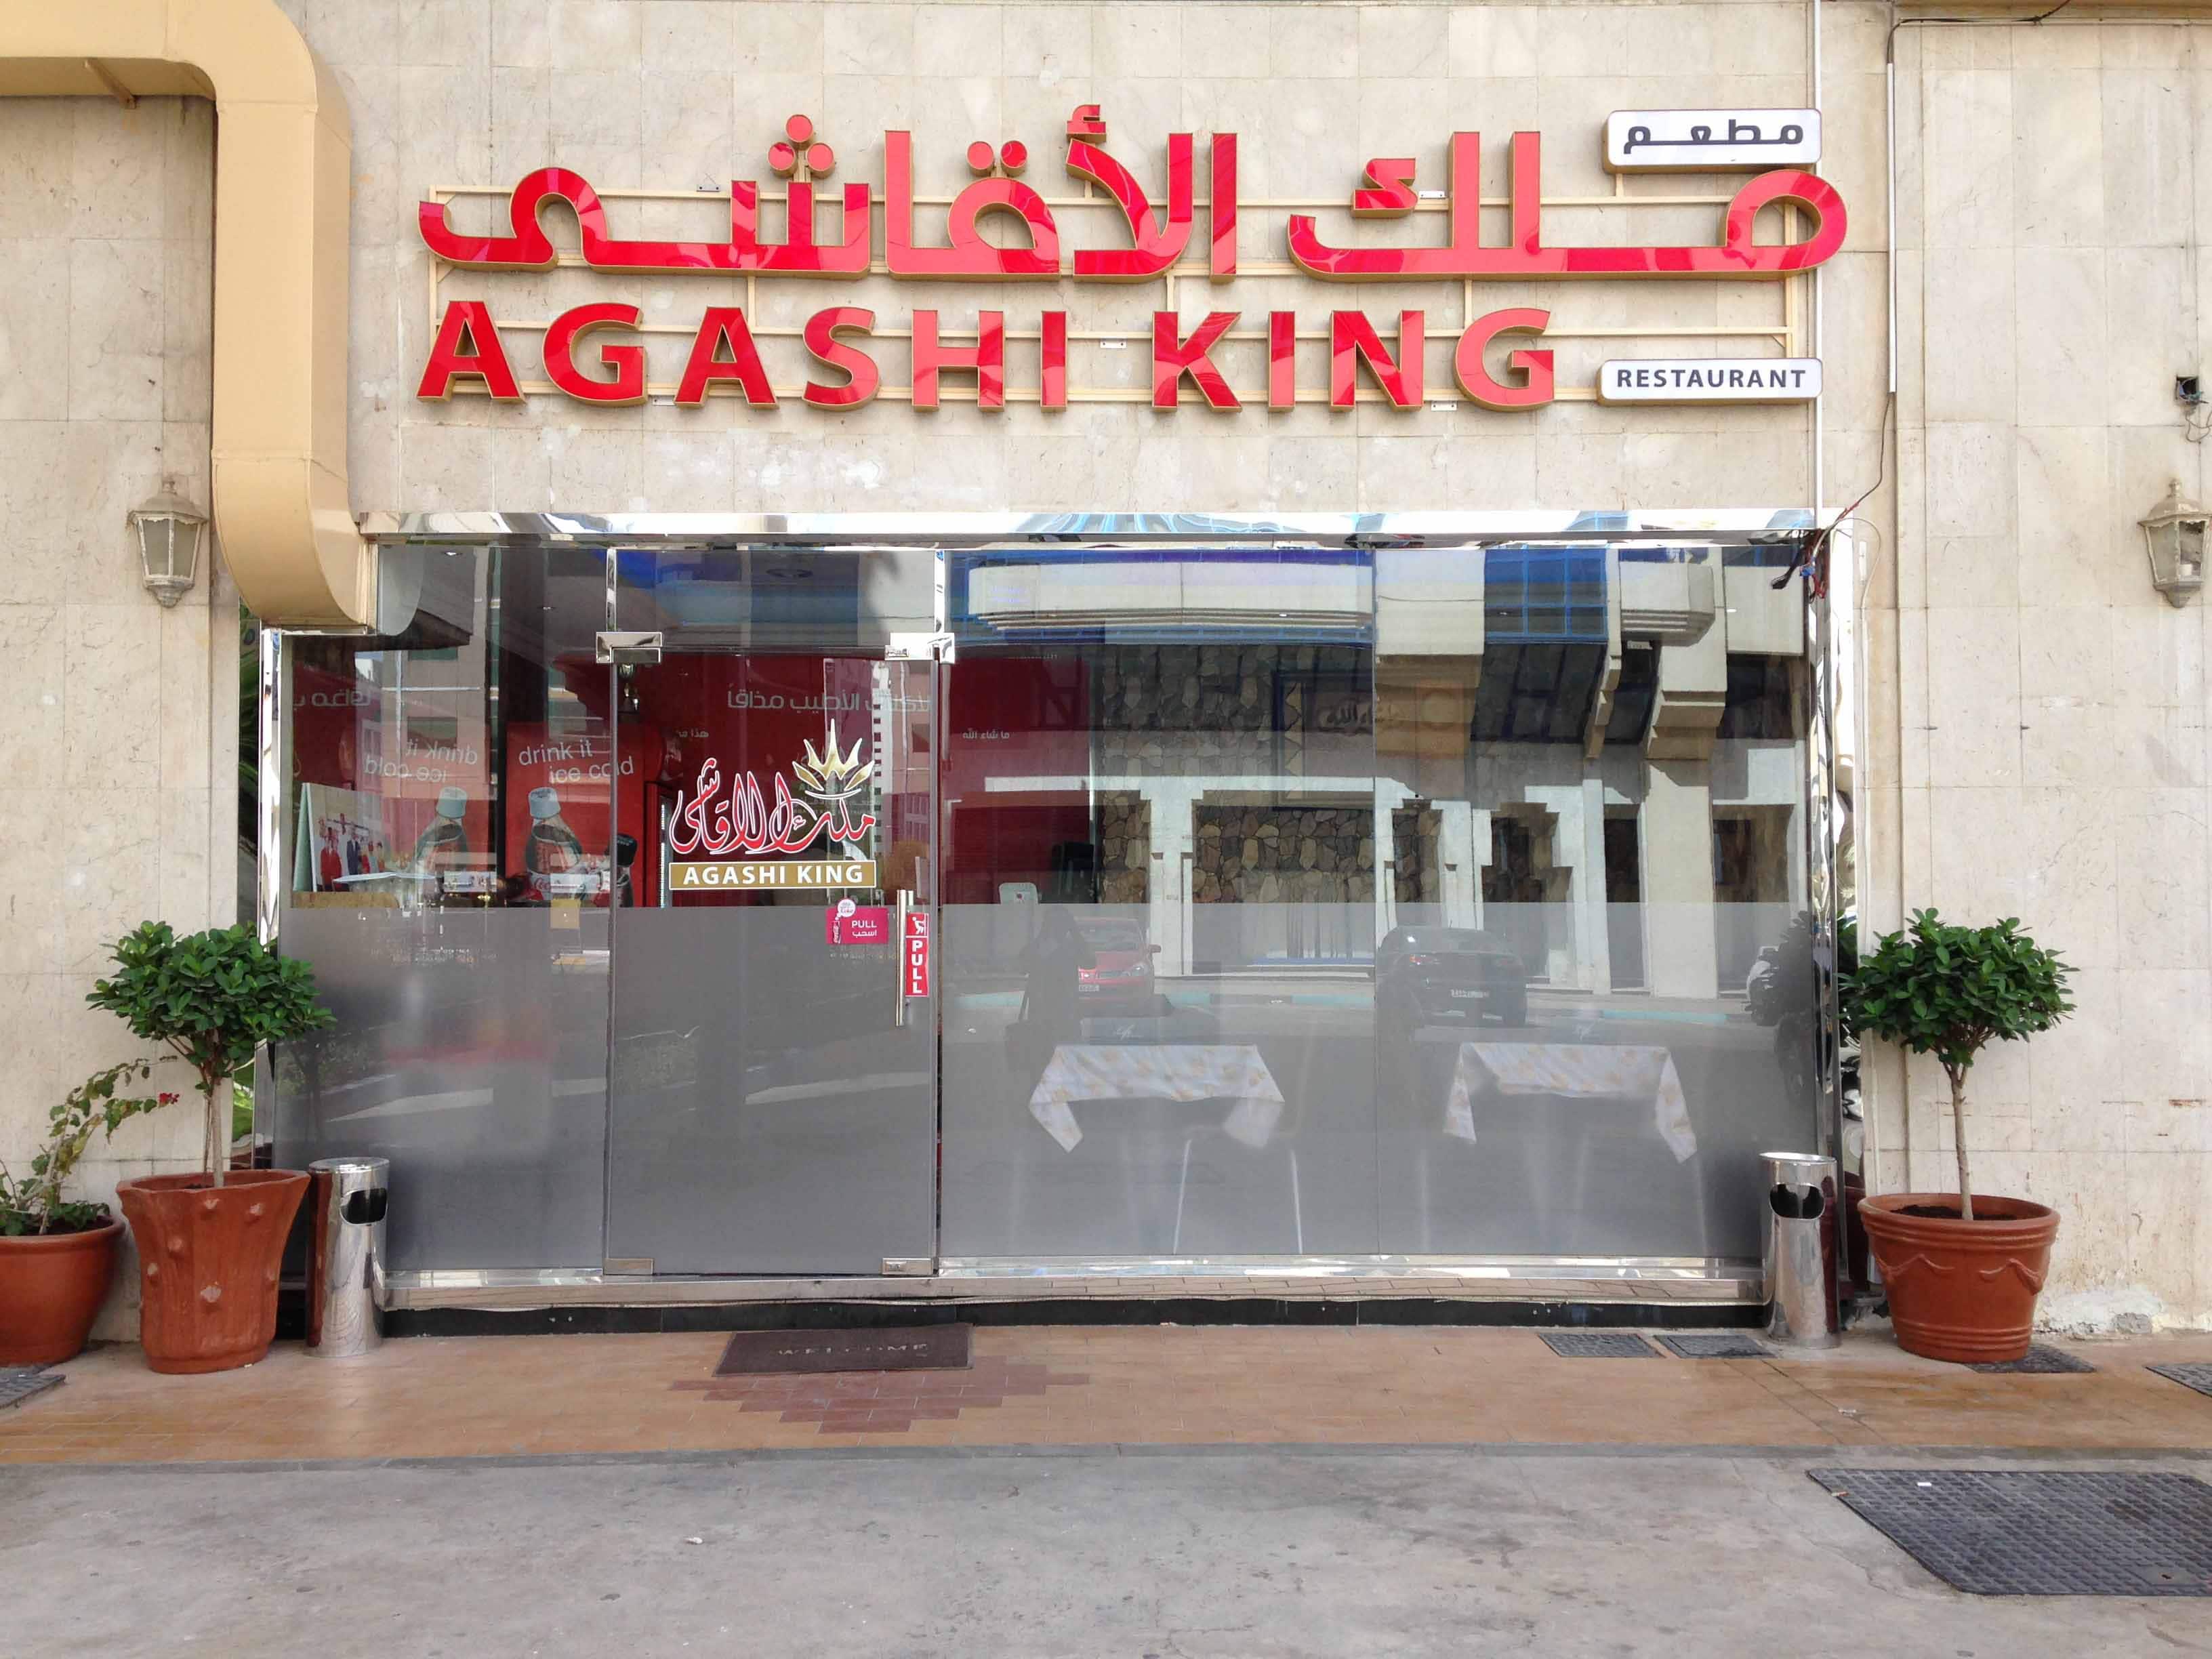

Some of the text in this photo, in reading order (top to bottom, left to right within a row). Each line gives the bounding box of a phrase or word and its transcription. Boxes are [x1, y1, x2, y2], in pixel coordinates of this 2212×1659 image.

[1624, 119, 1803, 154] مطعم
[1287, 131, 1846, 276] ملك
[416, 300, 1555, 412] AGASHI KING
[1617, 369, 1806, 388] RESTAURANT
[518, 739, 593, 766] drink it
[549, 765, 581, 784] ice
[683, 865, 863, 884] AGASHI KING
[851, 920, 877, 928] PULL
[852, 929, 877, 938] اسحب
[911, 940, 923, 994] PULL
